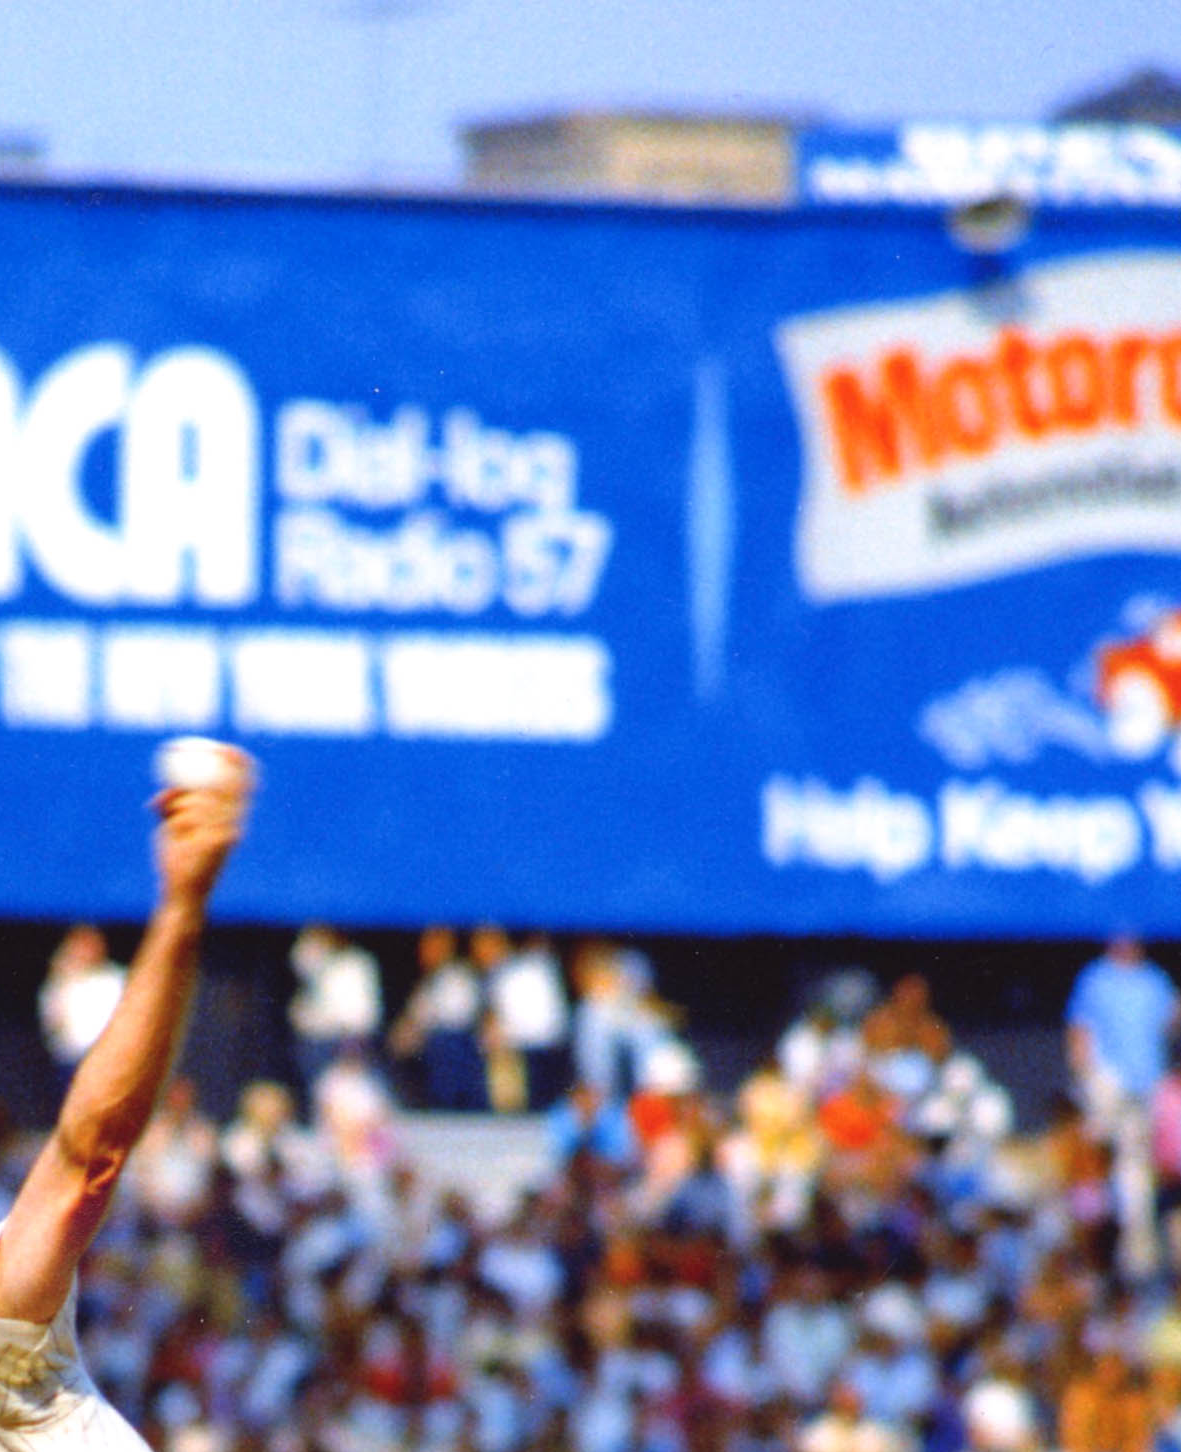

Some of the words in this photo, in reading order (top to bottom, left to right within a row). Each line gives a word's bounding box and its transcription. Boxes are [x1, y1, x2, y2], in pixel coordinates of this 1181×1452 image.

[273, 503, 498, 614] Radio
[763, 773, 932, 886] Help
[940, 776, 1141, 888] Keep
